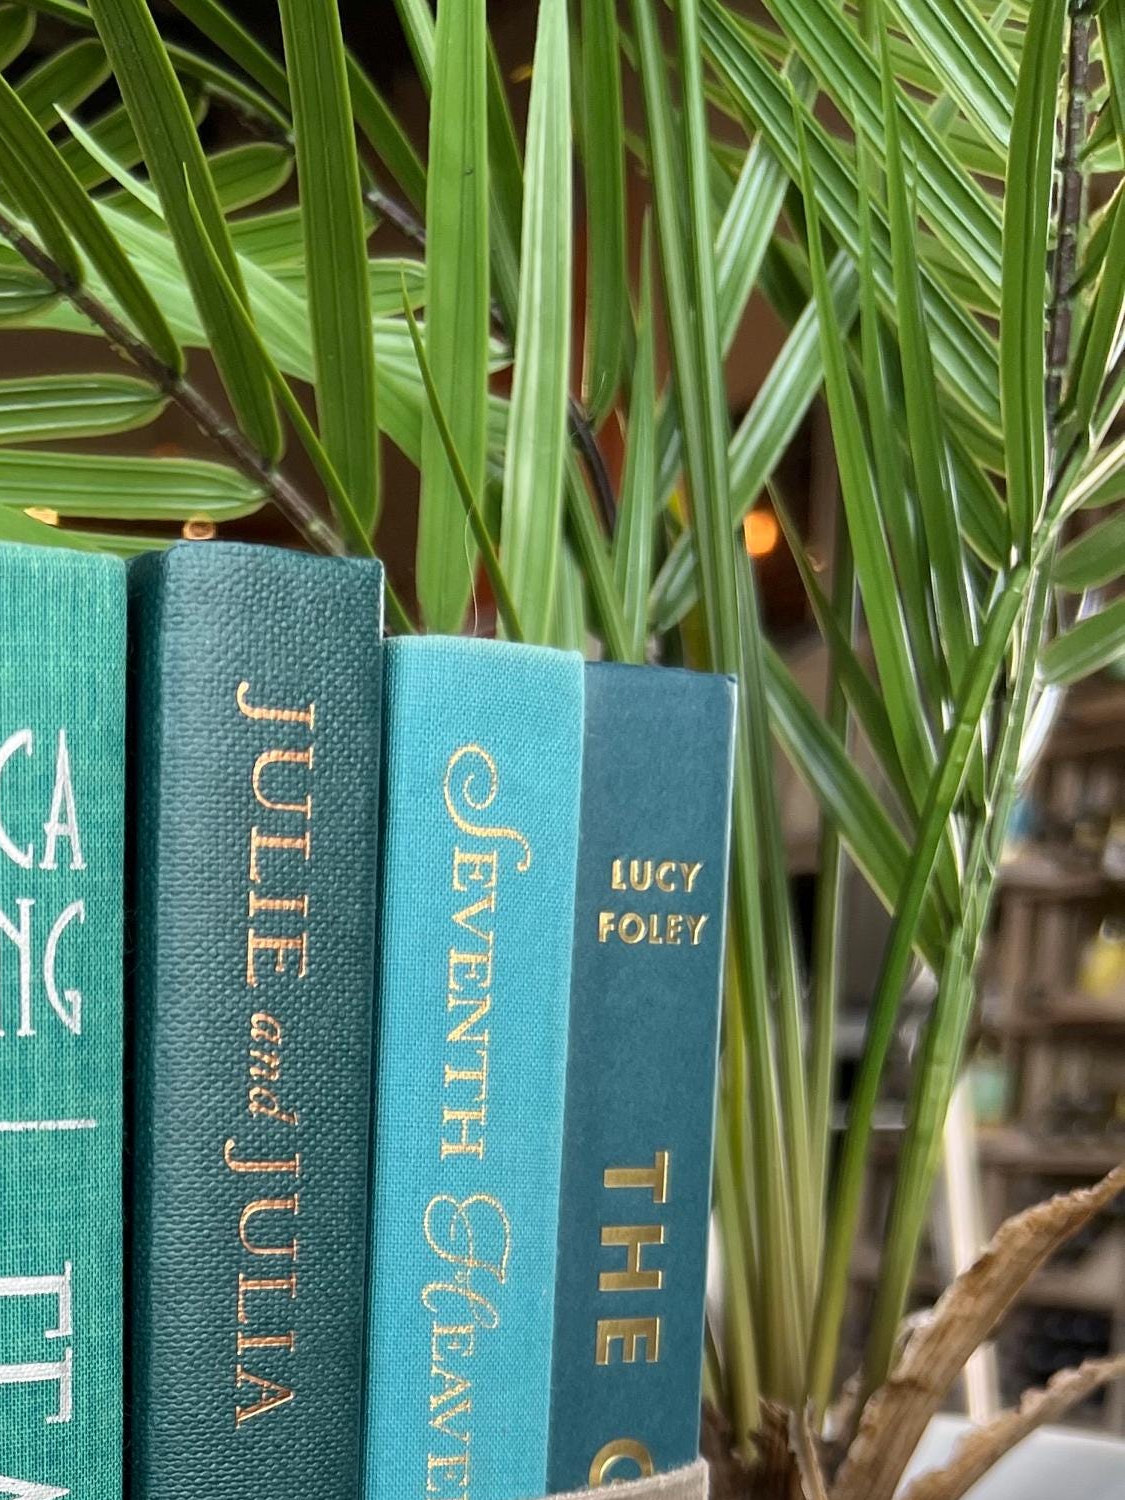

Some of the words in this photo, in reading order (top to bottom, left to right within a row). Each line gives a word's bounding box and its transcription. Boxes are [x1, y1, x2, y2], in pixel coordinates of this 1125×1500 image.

[236, 680, 315, 989] JULIE
[597, 911, 711, 946] FOLEY
[611, 858, 705, 893] LUCY
[440, 742, 532, 1162] SEVENTH
[247, 1011, 299, 1127] and
[224, 1138, 301, 1429] JULIA
[594, 1150, 670, 1367] THE
